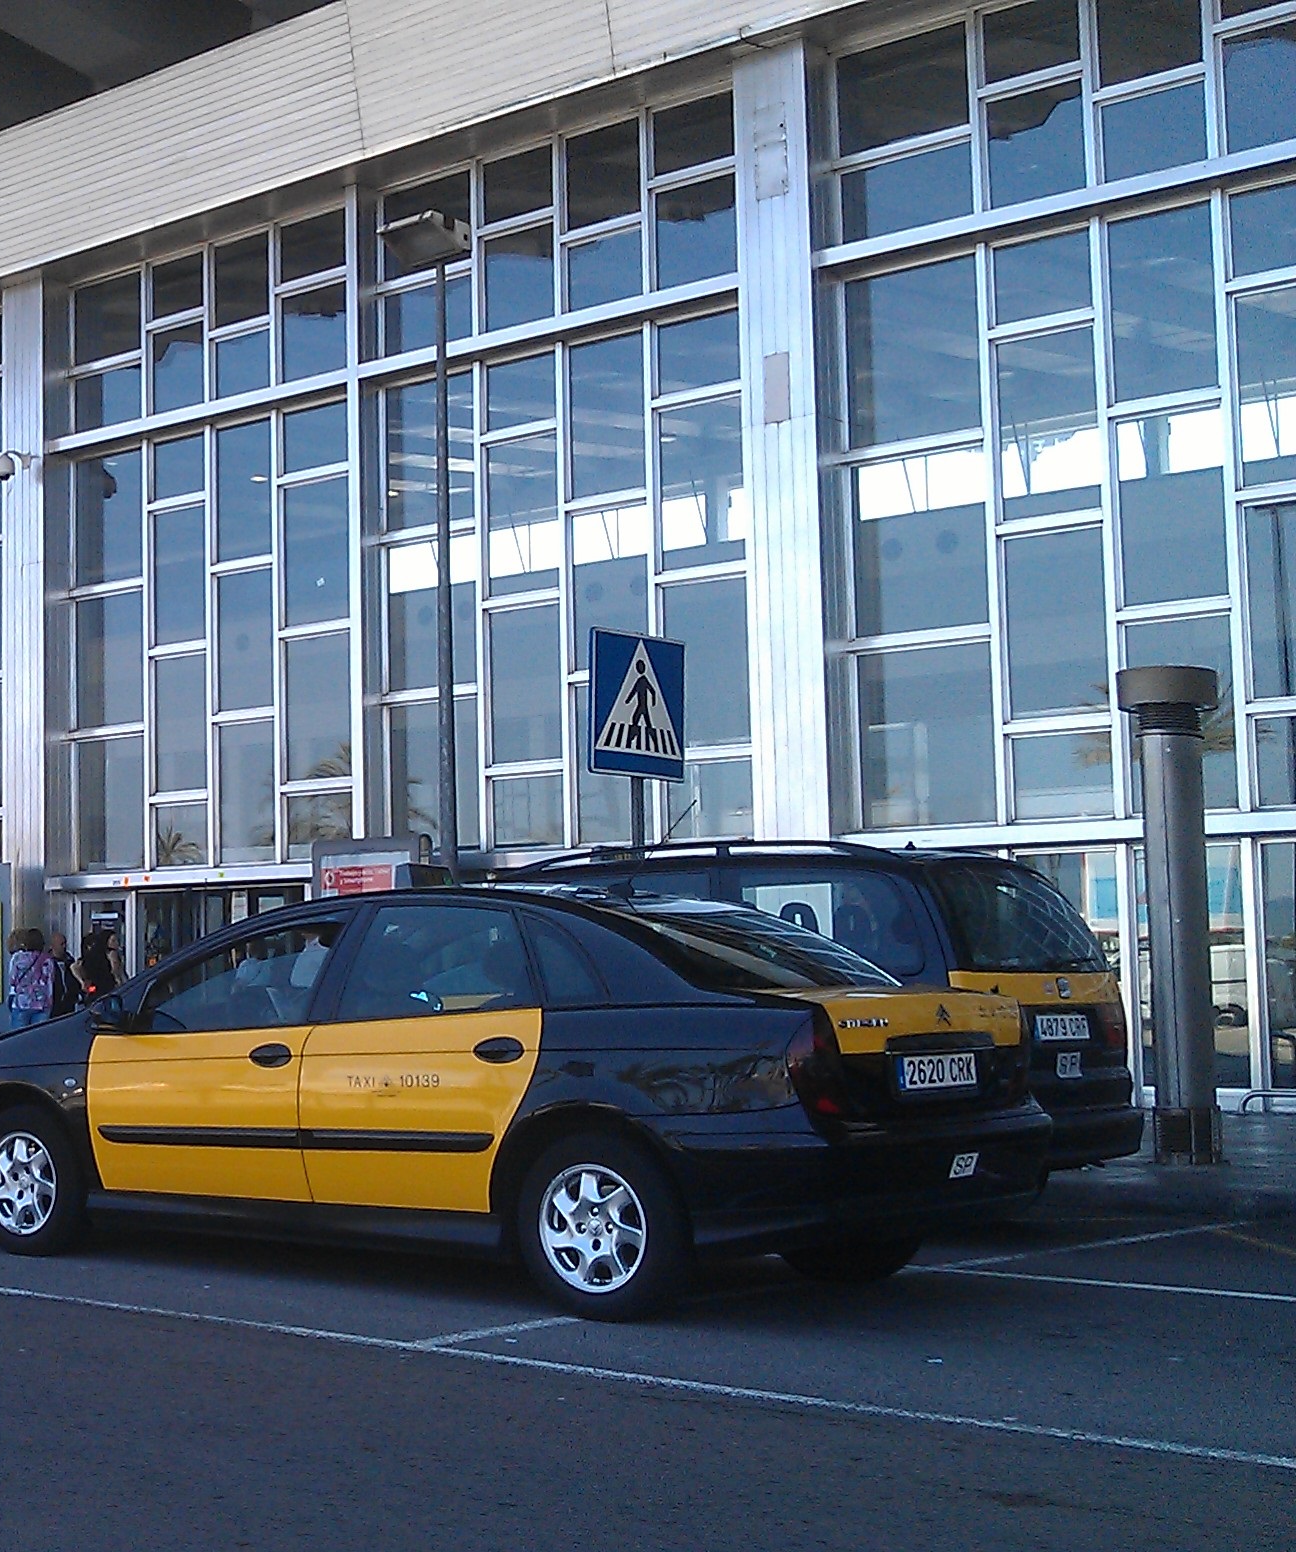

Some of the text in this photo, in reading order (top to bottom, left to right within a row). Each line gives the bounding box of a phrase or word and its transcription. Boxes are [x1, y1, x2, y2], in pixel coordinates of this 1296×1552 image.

[346, 1073, 441, 1088] TAXI 10139
[907, 1057, 975, 1086] 2620 CRK
[953, 1154, 974, 1176] SP
